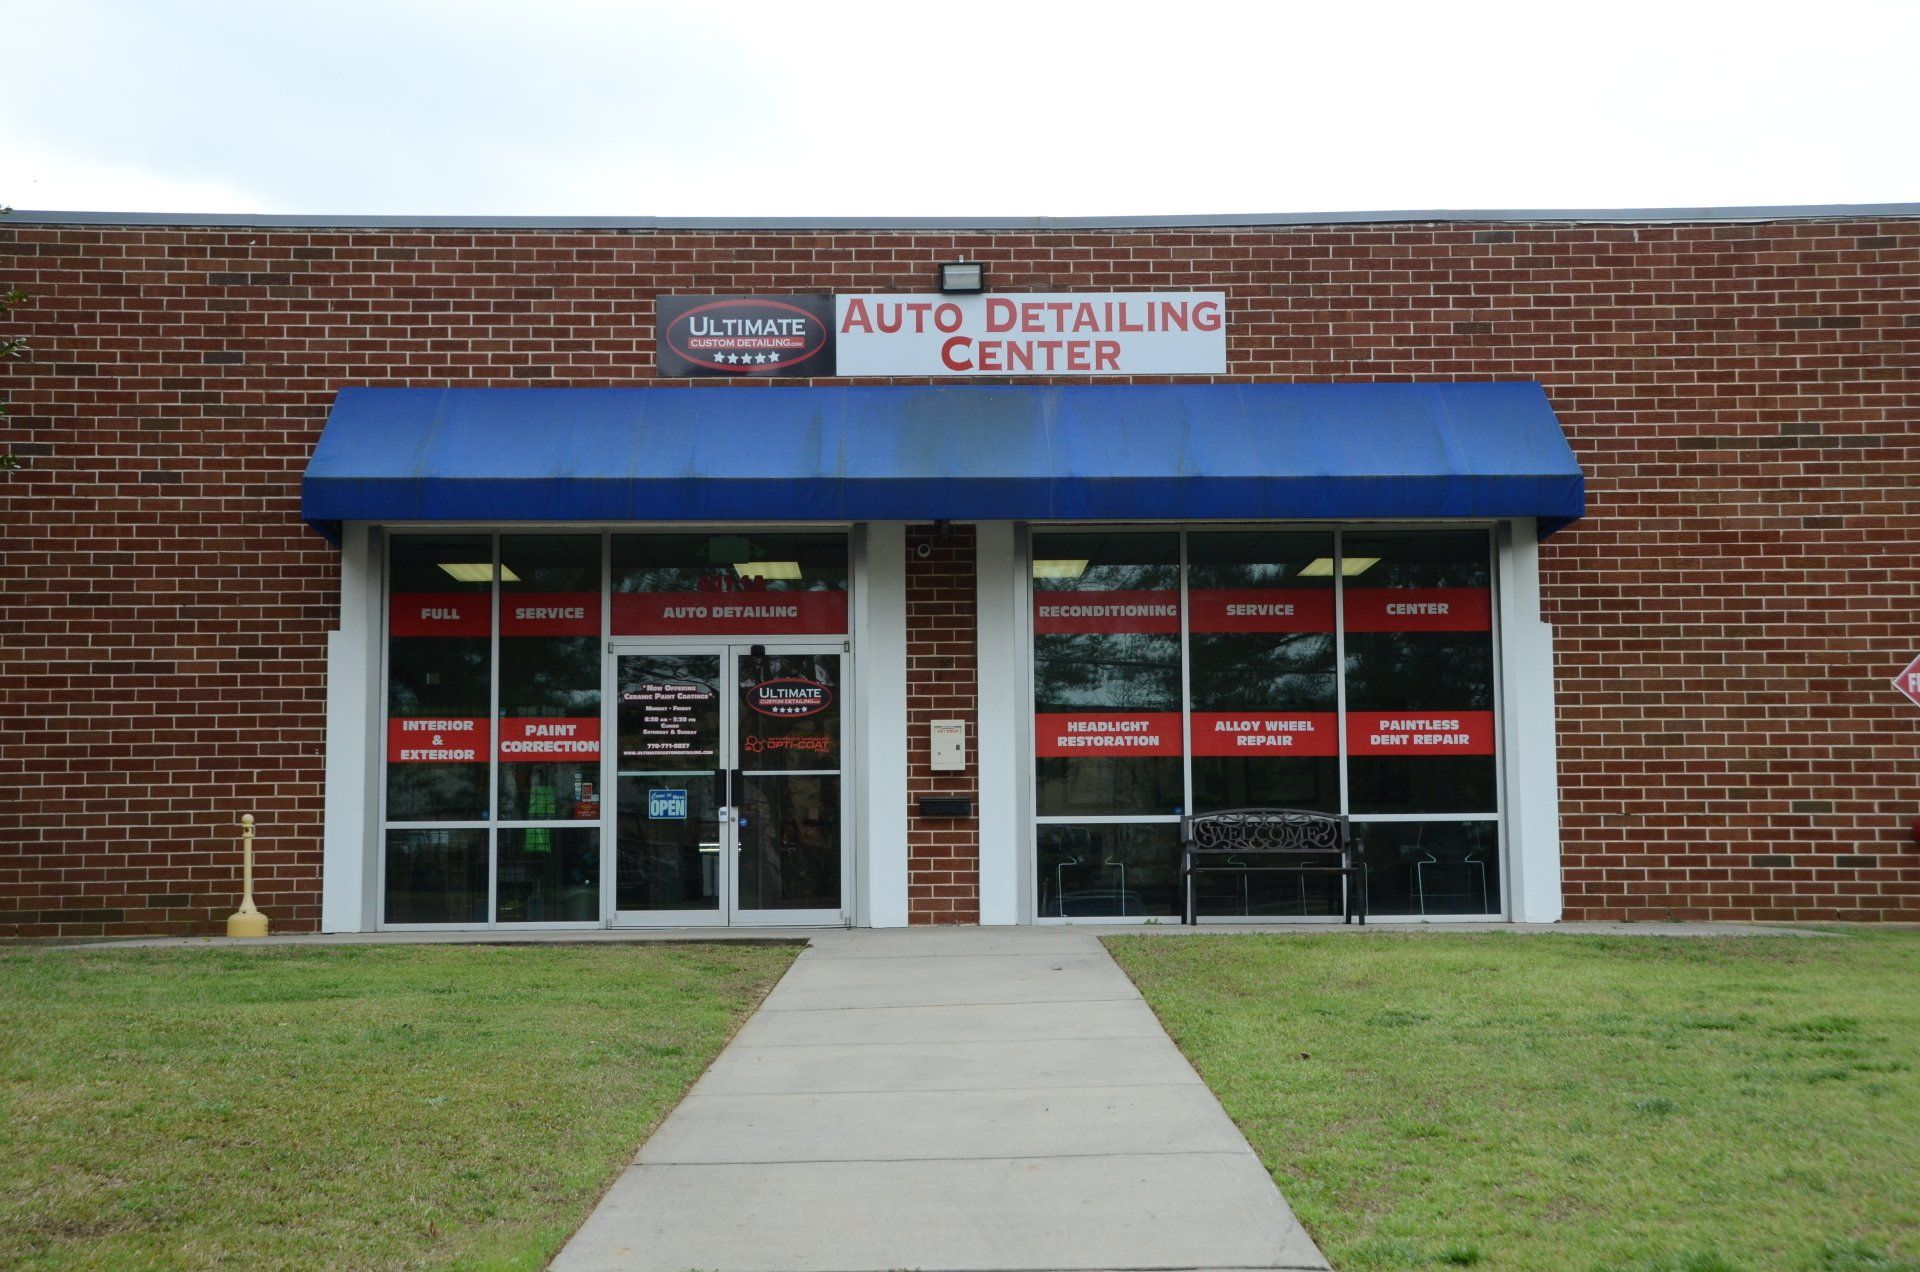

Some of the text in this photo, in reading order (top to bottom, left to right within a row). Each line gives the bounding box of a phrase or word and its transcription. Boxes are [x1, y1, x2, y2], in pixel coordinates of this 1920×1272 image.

[840, 297, 1222, 334] AUTO DETAILING
[689, 316, 806, 336] ULTIMATE
[691, 338, 735, 347] CUSTOM
[941, 336, 1121, 372] CENTER
[422, 607, 461, 620] FULL
[515, 607, 585, 620] SERVICE
[663, 605, 798, 619] AUTO DETAILING
[1039, 604, 1177, 618] RECONDITIONING
[1226, 603, 1295, 616] SERVICE
[1386, 602, 1449, 615] CENTER
[759, 687, 822, 698] ULTIMATE
[402, 720, 474, 731] INTERIOR
[525, 724, 577, 737] PAINT
[1067, 721, 1150, 732] HEADLIGHT
[1214, 720, 1315, 731] ALLOY WHEEL
[1379, 719, 1460, 730] PAINTLESS
[432, 734, 444, 746] &
[1057, 735, 1160, 747] RESTORATION
[1236, 735, 1293, 746] REPAIR
[1370, 733, 1470, 745] DENT REPAIR
[501, 740, 599, 753] CORRECTION
[400, 749, 475, 761] EXTERIOR
[650, 799, 685, 817] OPEN
[1210, 826, 1320, 841] WELCOME
